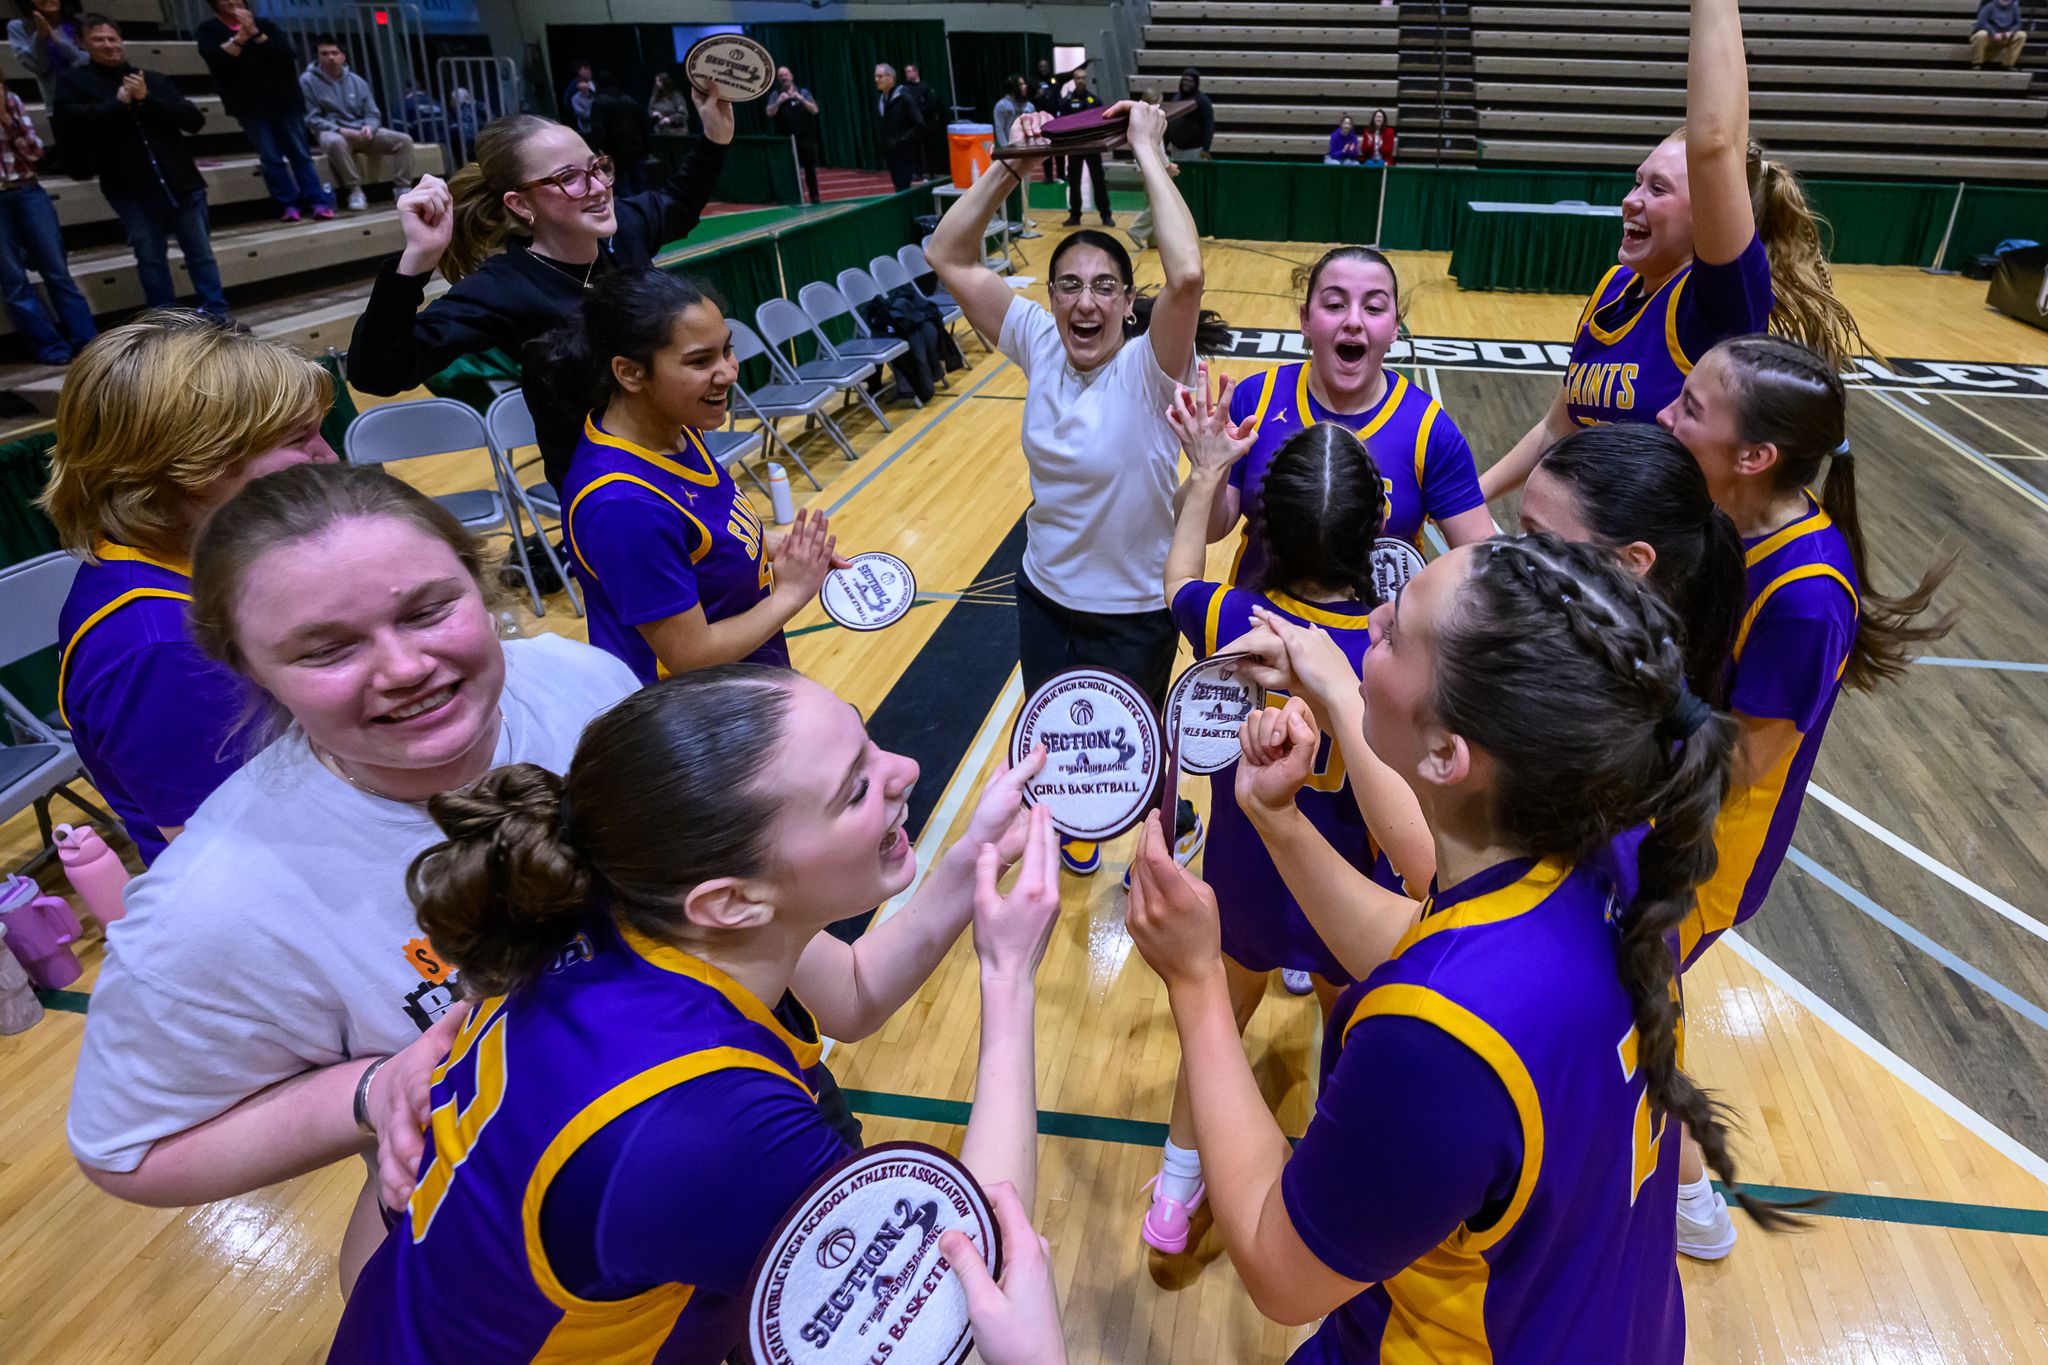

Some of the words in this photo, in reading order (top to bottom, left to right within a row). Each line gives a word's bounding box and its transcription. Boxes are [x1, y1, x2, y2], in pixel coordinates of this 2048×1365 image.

[857, 564, 887, 599] SECTION
[1026, 710, 1040, 735] STATE
[1036, 690, 1058, 713] PUBLIC
[1059, 681, 1077, 695] HIGH
[1077, 680, 1108, 693] SCHOOL
[1191, 682, 1241, 702] SECTION
[1040, 729, 1111, 754] SECTION
[1113, 727, 1128, 749] 2
[1034, 784, 1066, 796] GIRLS
[1068, 782, 1140, 795] BASKETBALL
[850, 1164, 909, 1193] ATHLETIC
[908, 1165, 970, 1218] ASSOCIATION
[802, 1188, 849, 1235] SCHOOL
[780, 1233, 806, 1269] HIGH
[800, 1218, 906, 1349] SECTION
[893, 1198, 926, 1230] 2
[766, 1270, 788, 1320] PUBLIC
[766, 1320, 787, 1360] STATE
